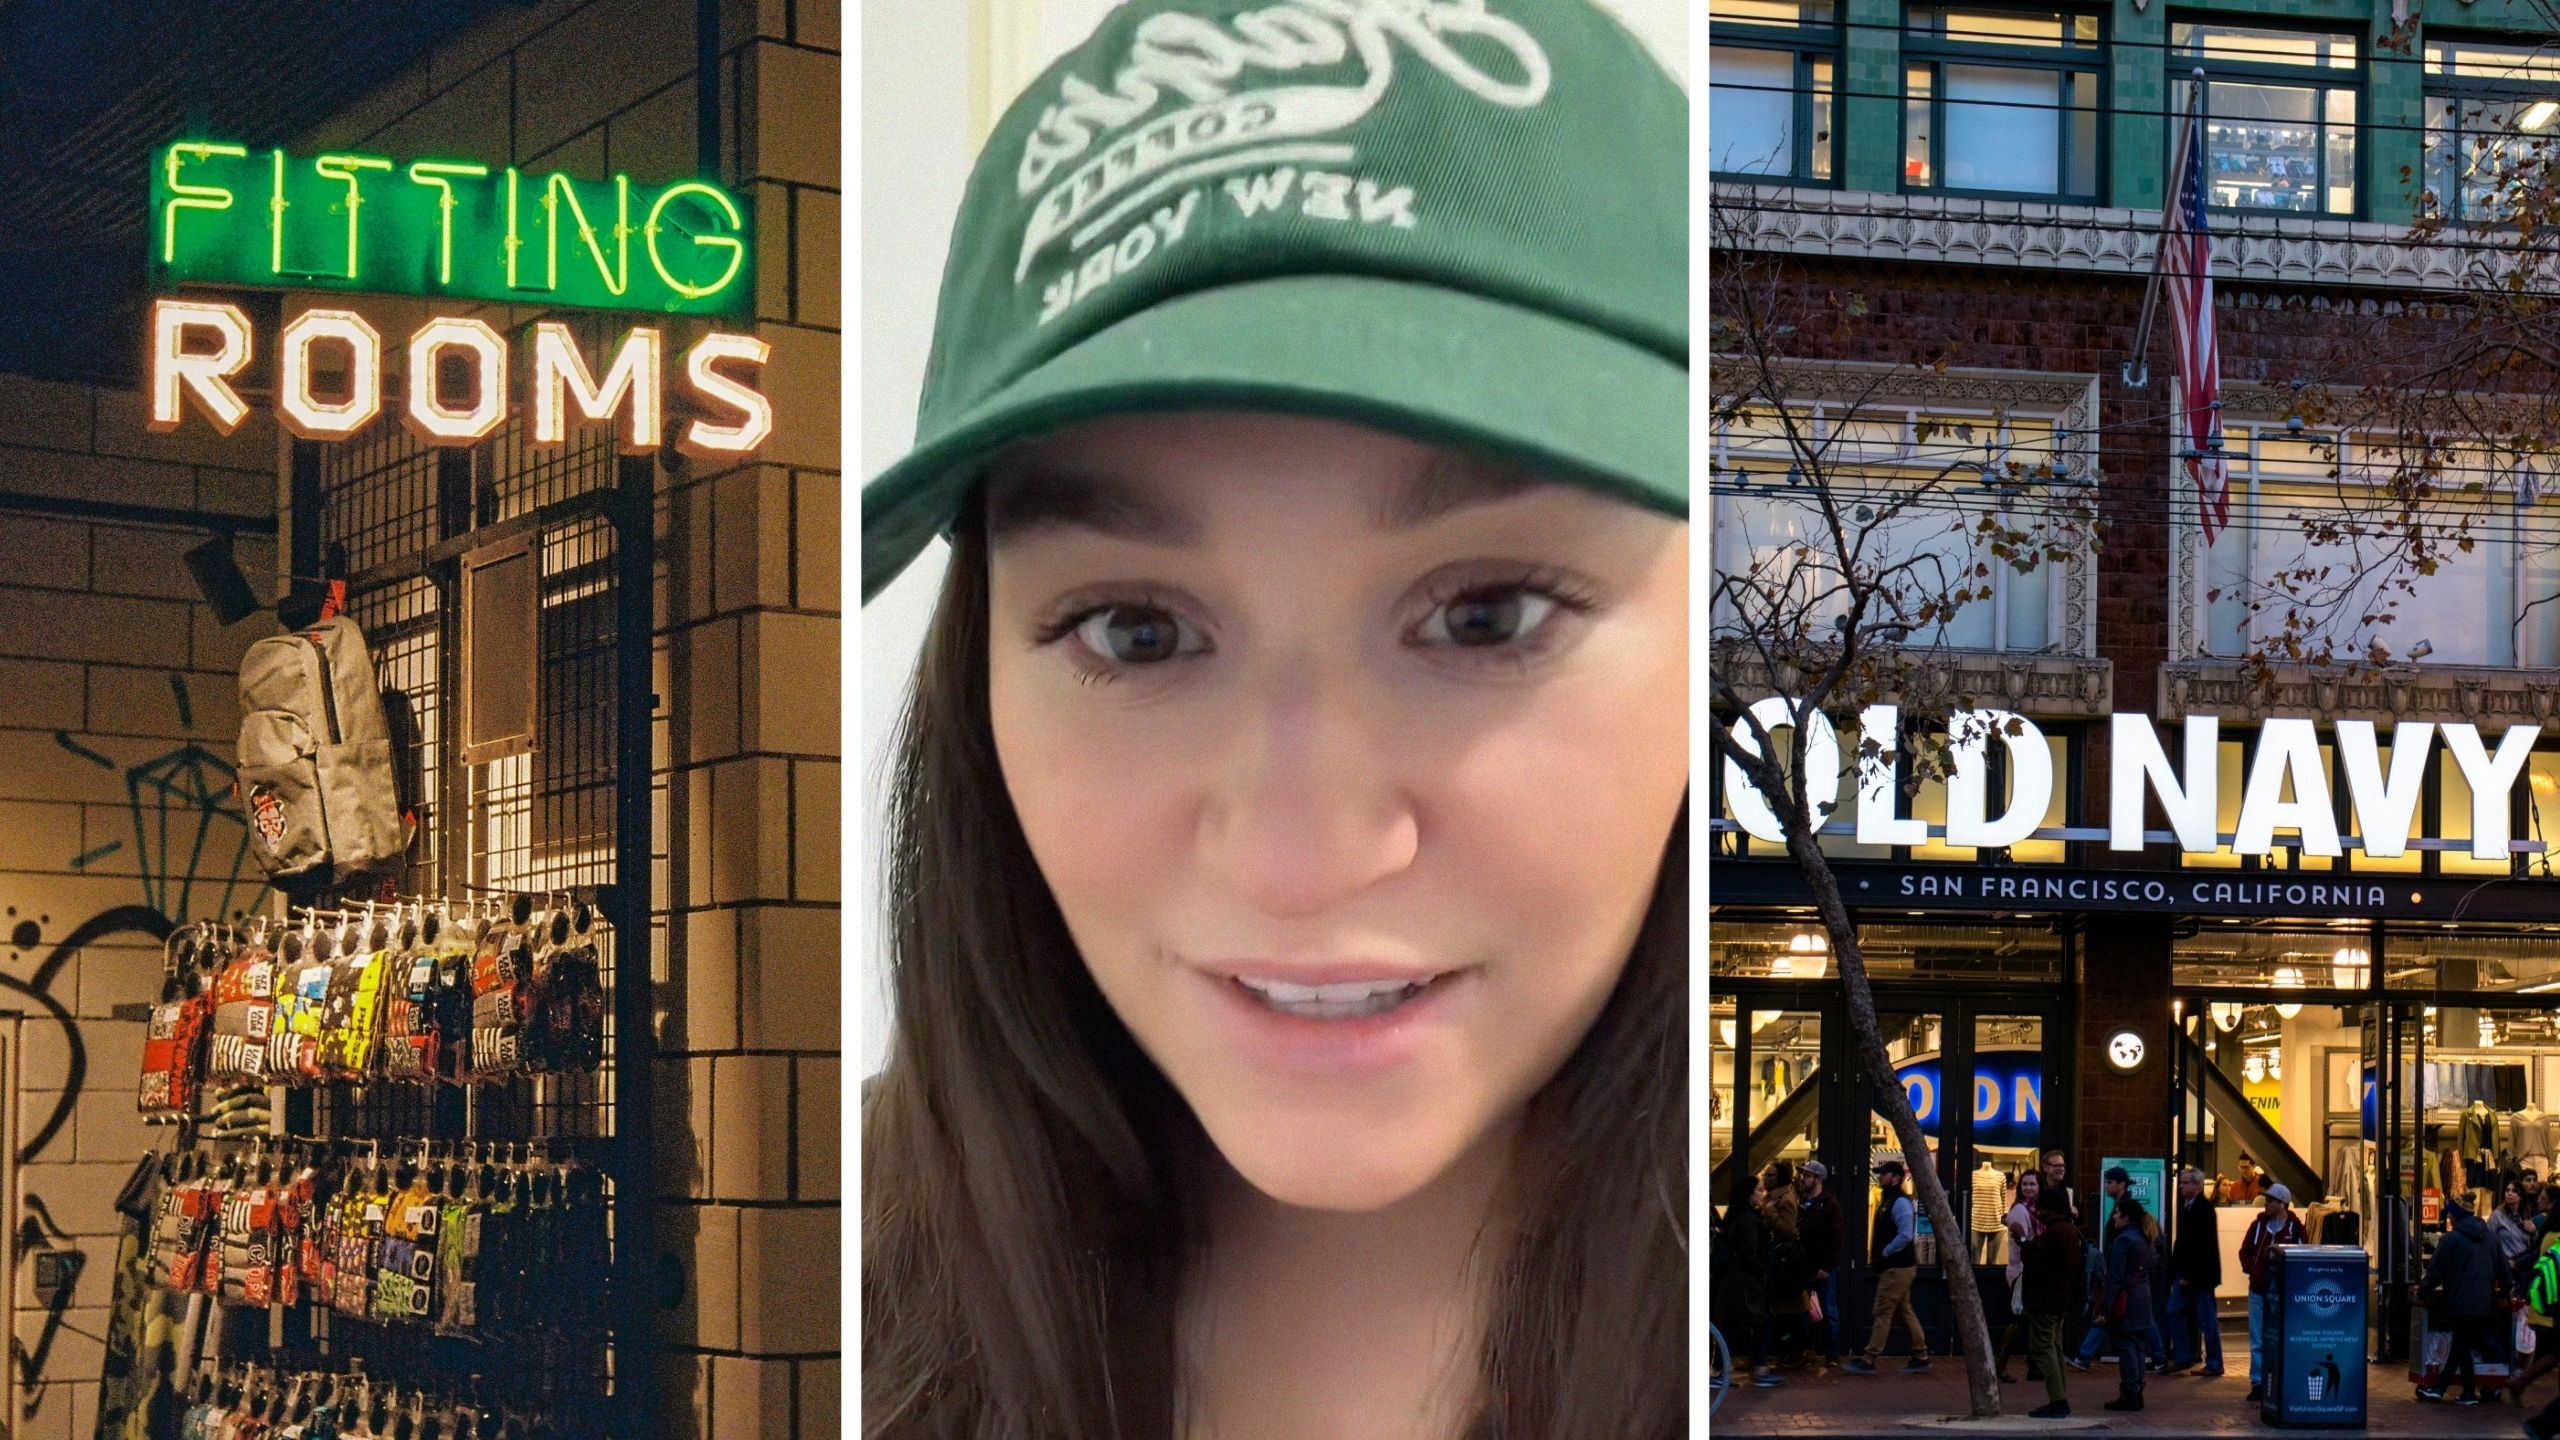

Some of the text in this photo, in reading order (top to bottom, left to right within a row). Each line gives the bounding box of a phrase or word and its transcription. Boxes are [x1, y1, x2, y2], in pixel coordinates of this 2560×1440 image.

[164, 142, 744, 297] FITTING
[152, 299, 773, 452] ROOMS
[1723, 696, 2542, 860] OLD NAVY
[1901, 875, 2386, 907] SAN FRANCISCO, CALIFORNIA
[2294, 1294, 2357, 1304] UNION SQUARE
